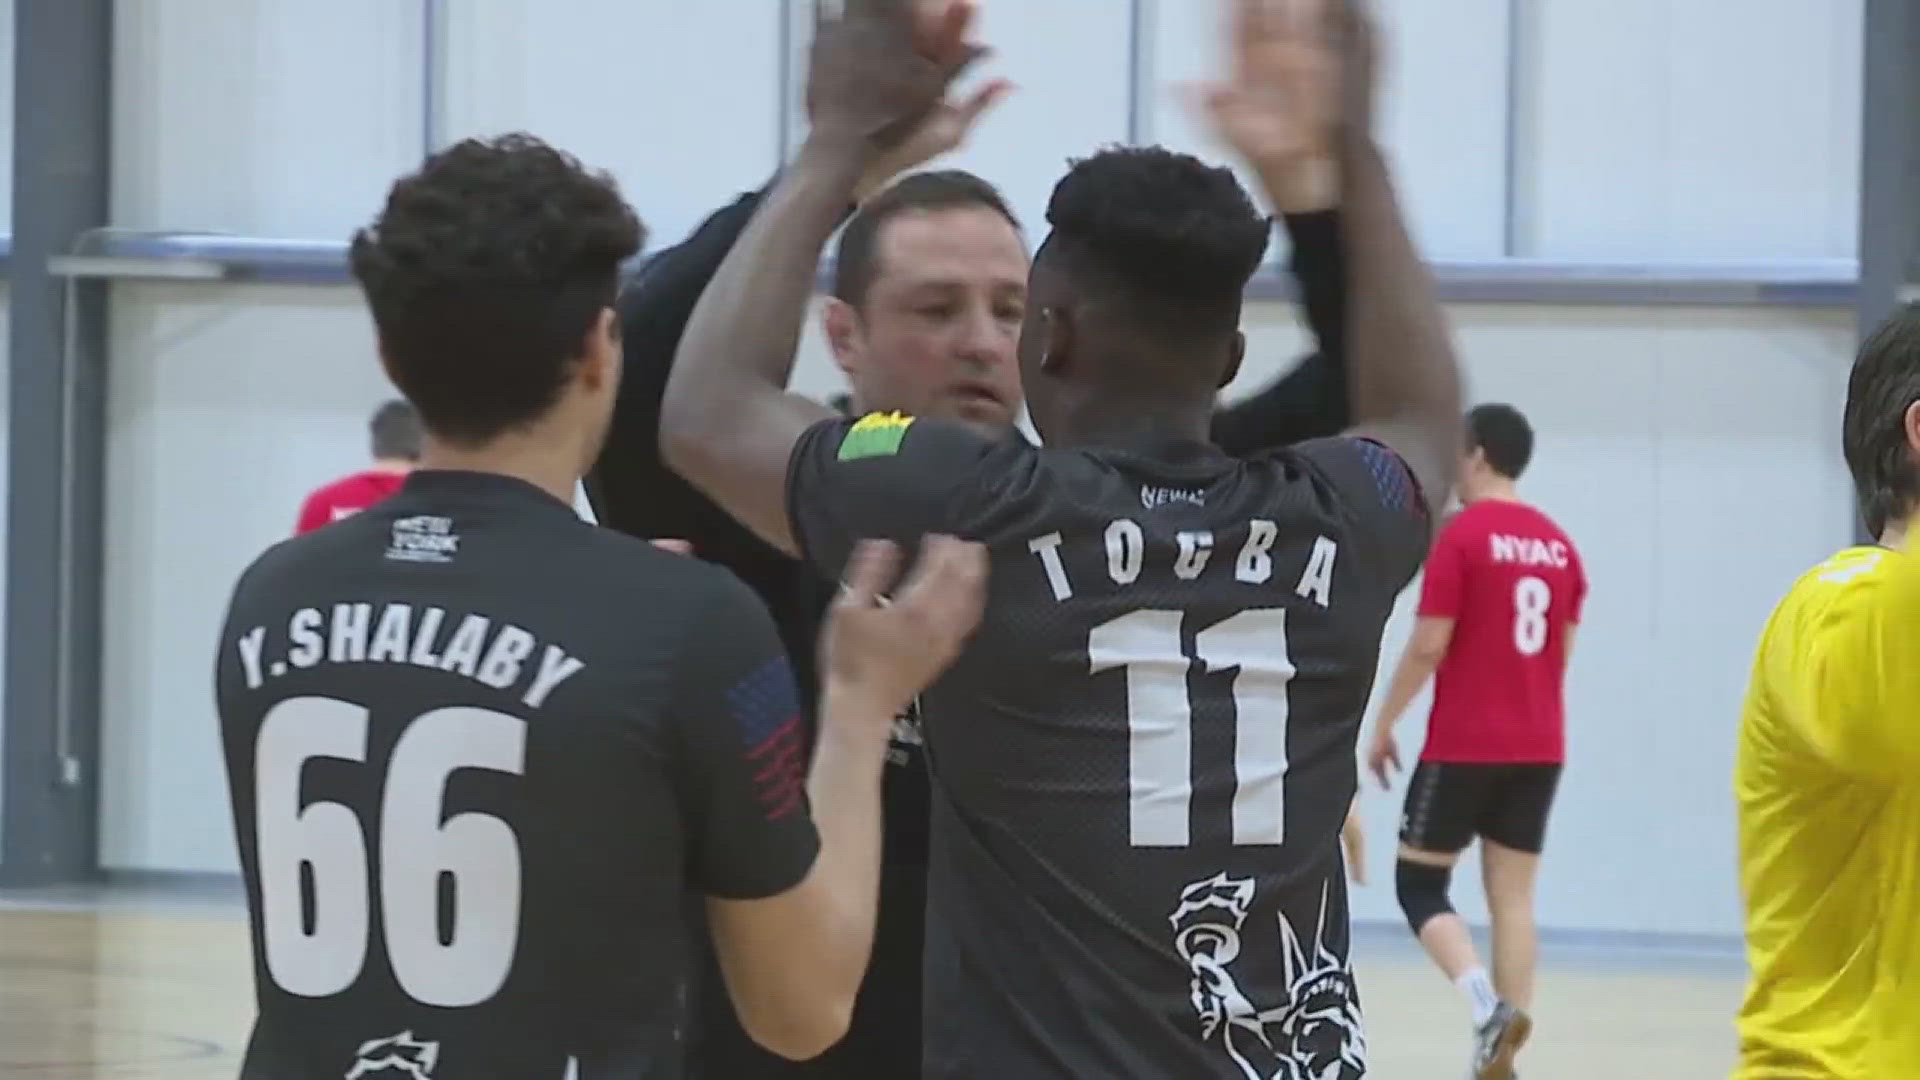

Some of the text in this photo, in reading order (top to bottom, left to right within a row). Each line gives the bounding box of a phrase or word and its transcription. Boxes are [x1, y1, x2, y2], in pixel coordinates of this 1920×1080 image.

[1028, 518, 1337, 609] TOGBA
[1488, 532, 1569, 569] NYAC
[238, 603, 588, 710] Y.SHALABY
[1515, 576, 1551, 656] 8
[1087, 608, 1297, 847] 11
[254, 696, 528, 1008] 66
